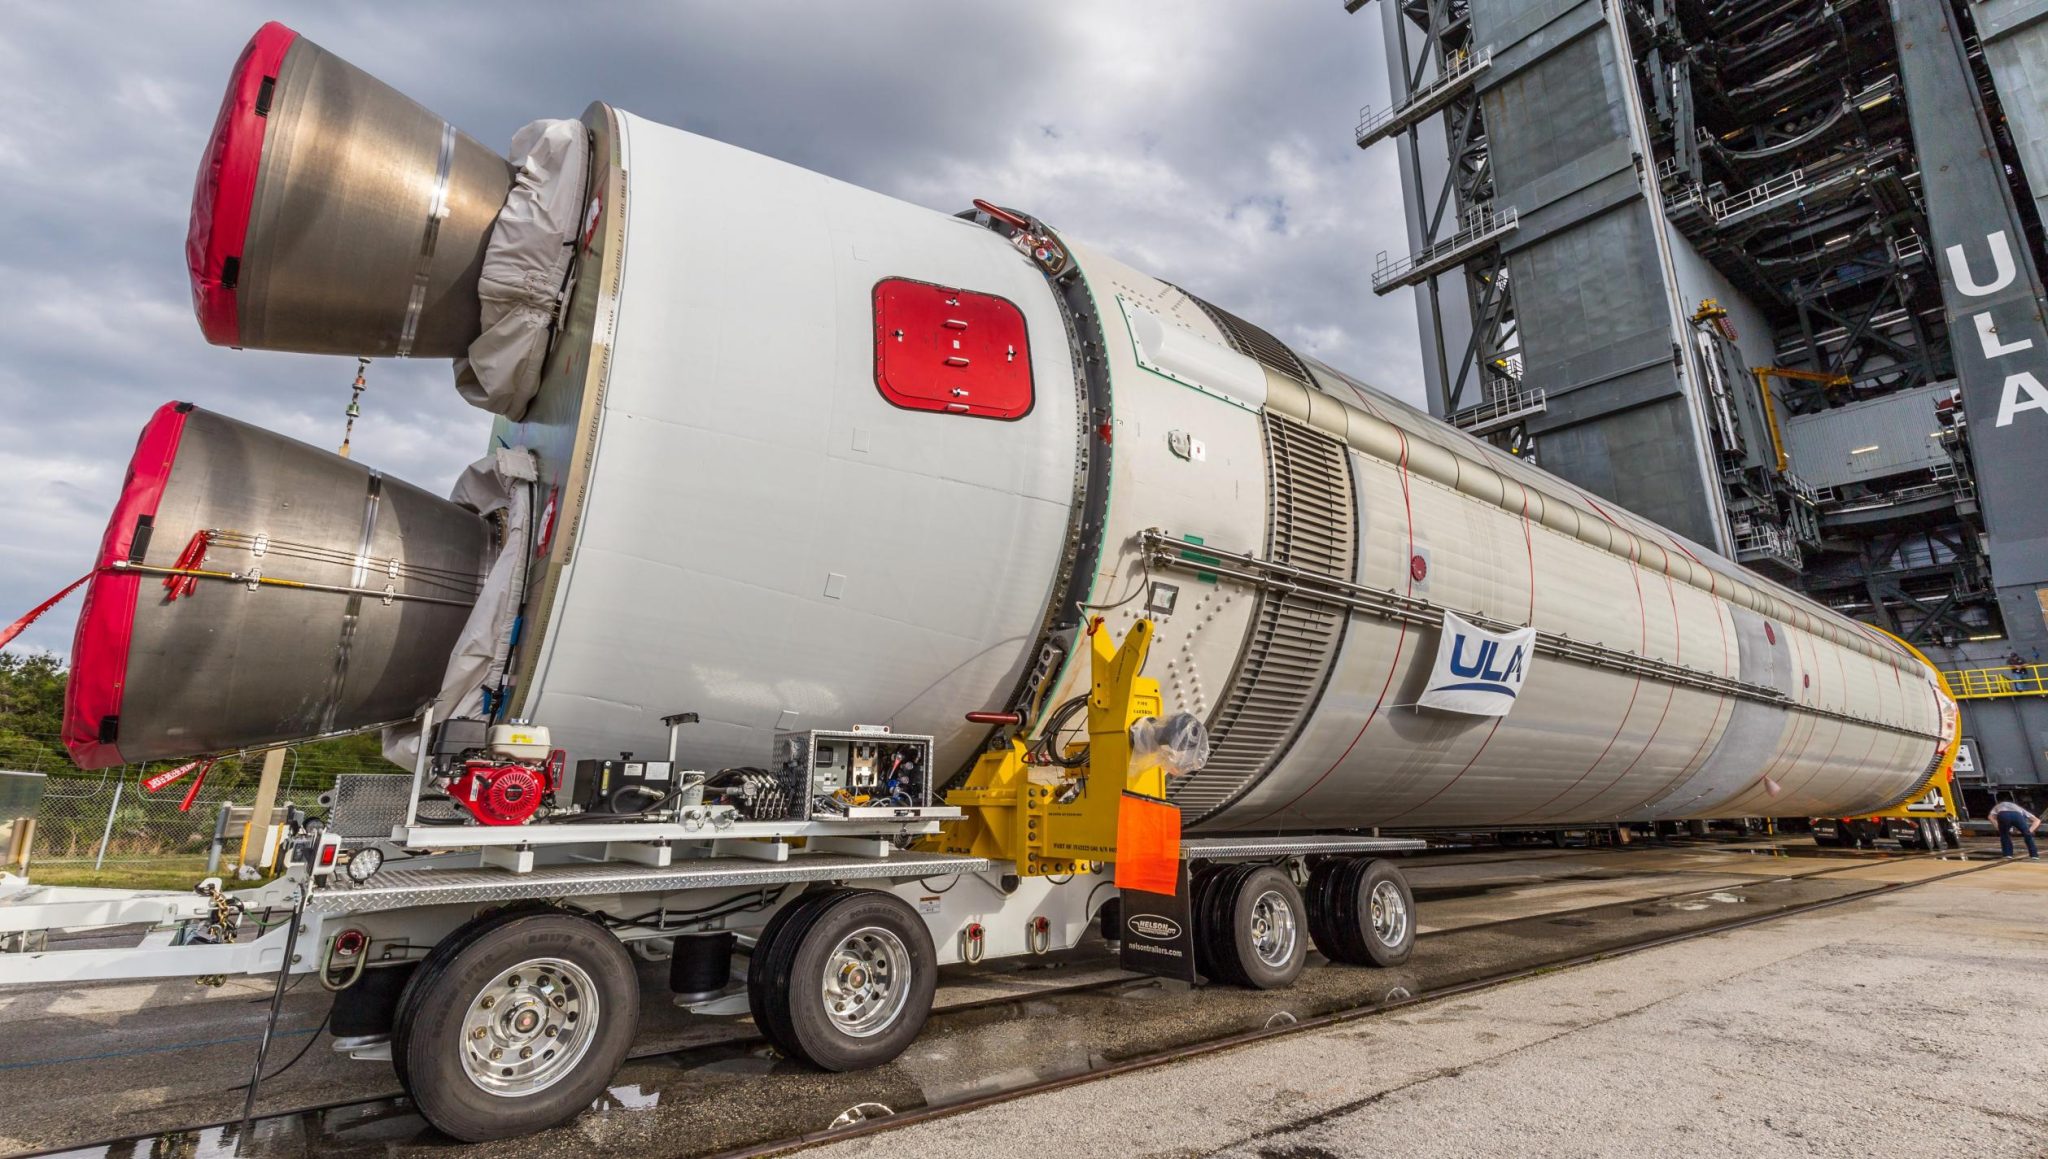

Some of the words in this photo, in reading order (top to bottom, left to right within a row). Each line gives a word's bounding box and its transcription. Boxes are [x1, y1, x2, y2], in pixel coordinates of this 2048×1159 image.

[1449, 633, 1528, 684] ULA
[1139, 920, 1169, 931] NELSON
[1128, 941, 1183, 958] nelsontrailers.com
